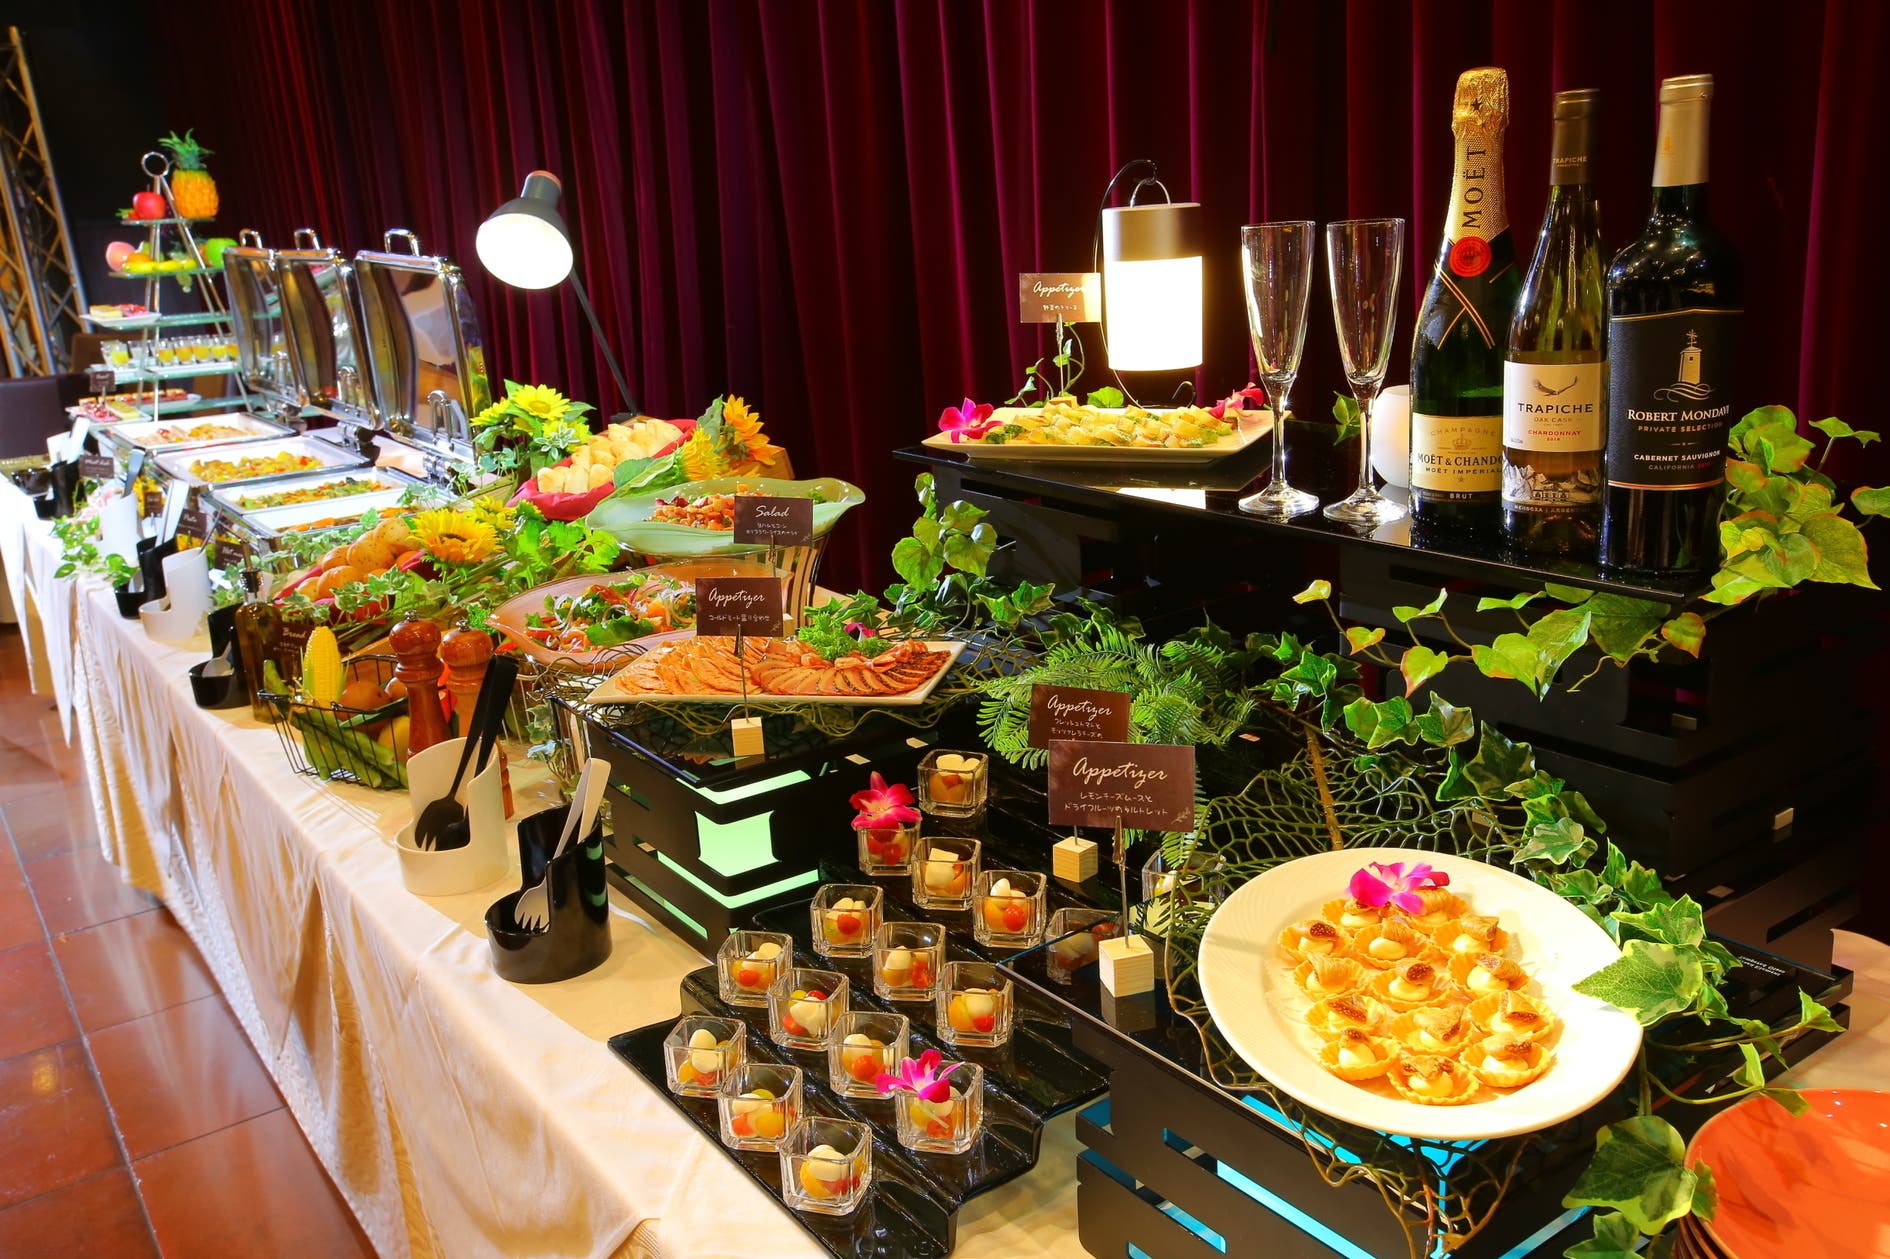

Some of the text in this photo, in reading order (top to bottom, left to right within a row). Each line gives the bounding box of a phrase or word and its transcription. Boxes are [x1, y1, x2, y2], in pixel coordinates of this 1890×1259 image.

[1462, 147, 1486, 229] MOËT
[1518, 402, 1594, 414] TRAPICHE
[1627, 409, 1678, 422] ROBERT
[1430, 427, 1497, 437] CHAMPAGNE
[1445, 458, 1452, 466] &
[1633, 454, 1679, 462] CABERNET
[755, 505, 790, 518] Salad
[708, 587, 766, 609] Appetizer
[1047, 694, 1112, 722] Appetizer
[1072, 757, 1168, 790] Appetizer
[1080, 791, 1153, 803] レモンチーズムースと
[1064, 802, 1168, 815] ドライフルーツのタルトレット
